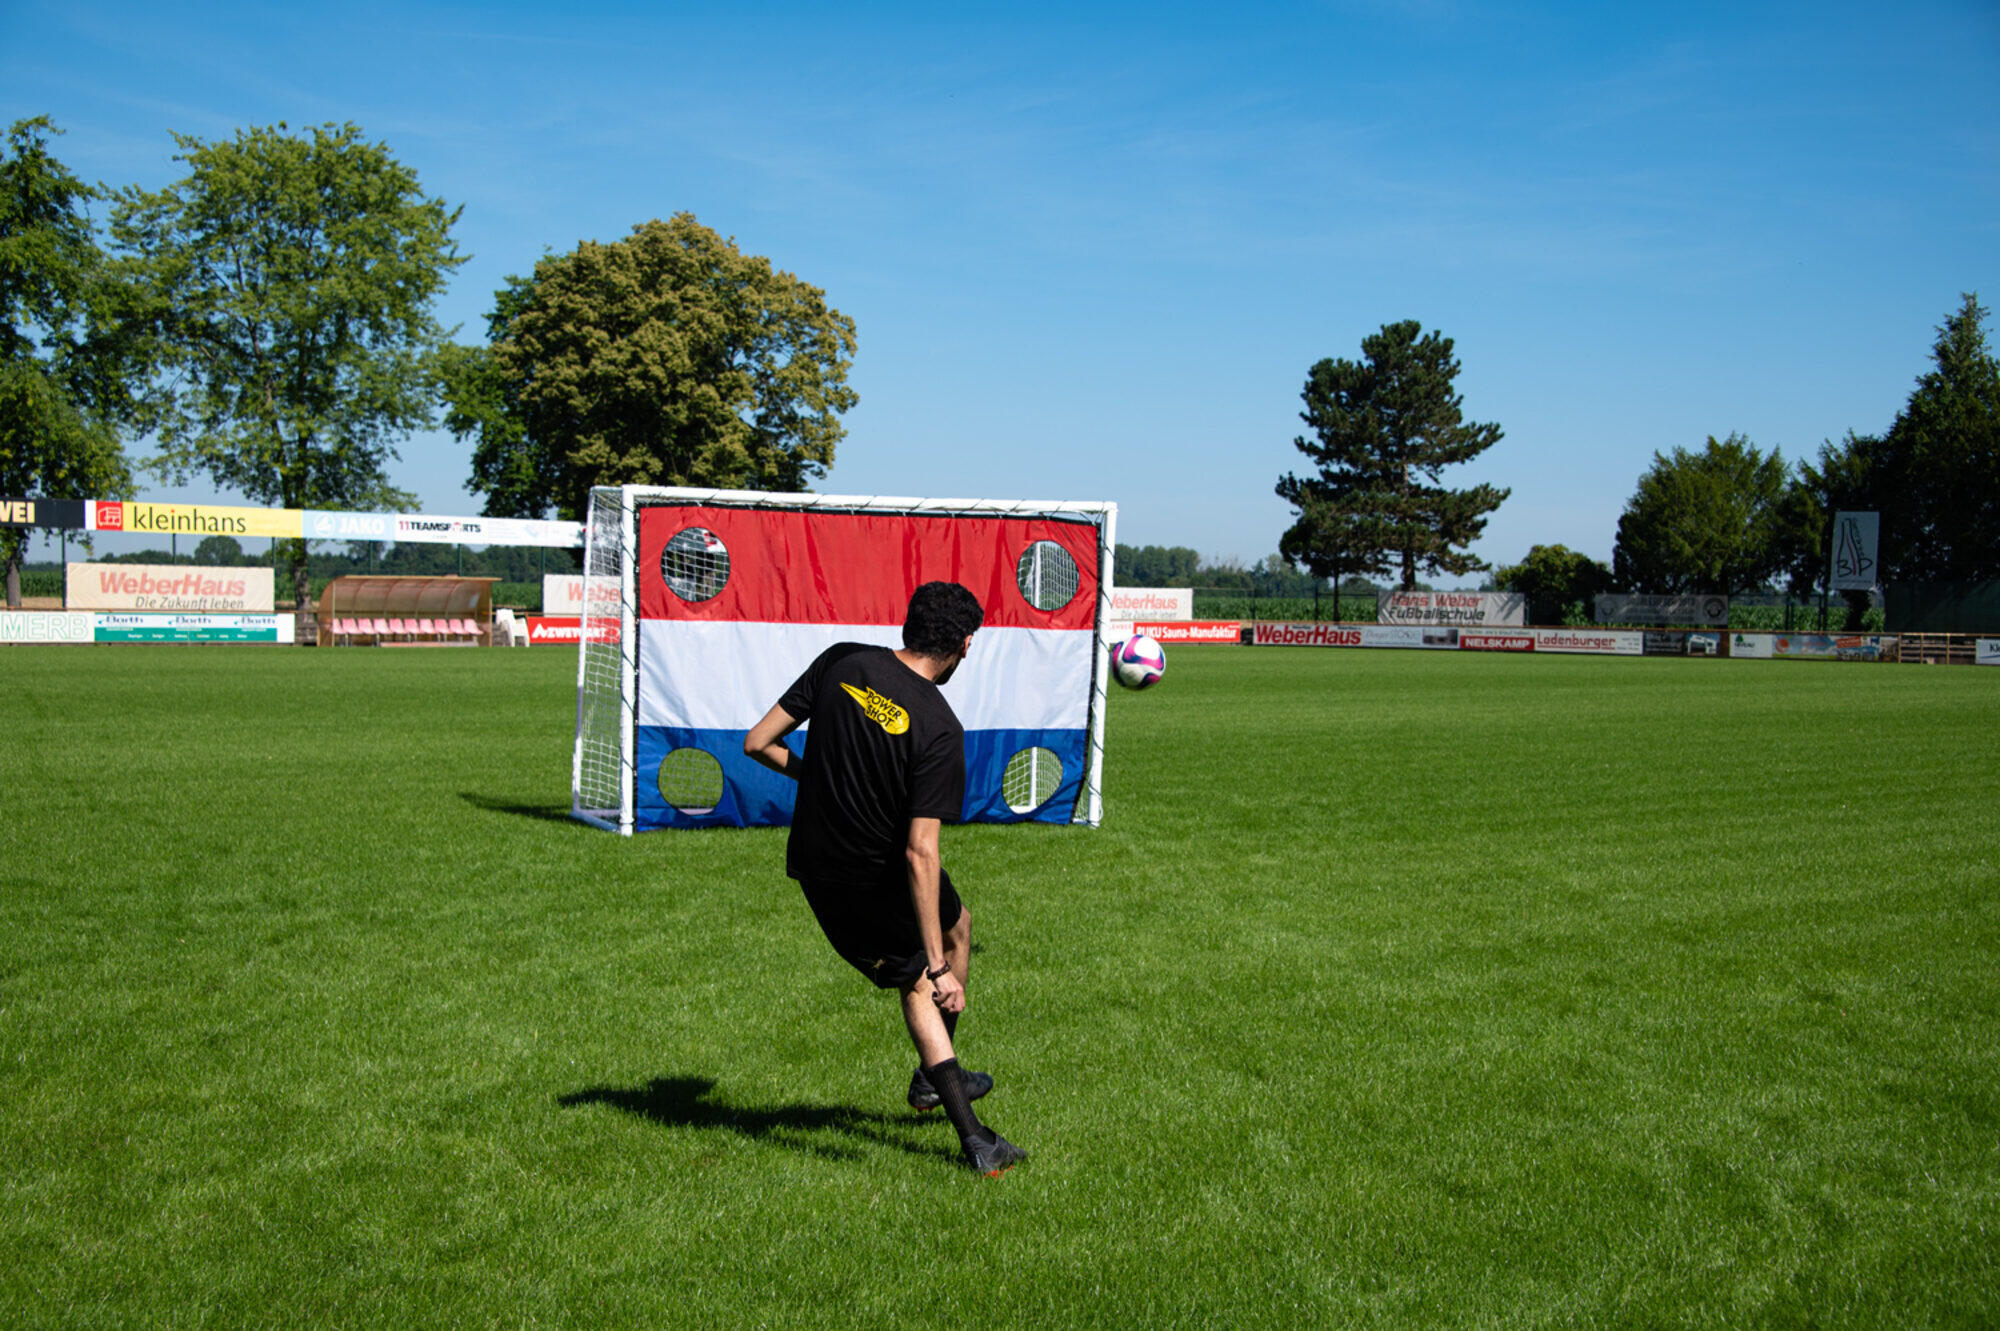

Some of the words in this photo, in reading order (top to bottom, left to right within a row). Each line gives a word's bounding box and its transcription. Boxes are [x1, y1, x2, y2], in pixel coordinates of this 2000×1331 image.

[133, 506, 246, 533] kleinhans
[339, 518, 384, 535] JAKO
[100, 571, 245, 596] WeberHaus
[135, 596, 157, 608] Die
[160, 597, 208, 609] Zukunft
[210, 598, 244, 609] leben
[1112, 593, 1178, 610] eberHaus
[1391, 594, 1428, 607] Hans
[1435, 594, 1482, 607] Weber
[1389, 607, 1485, 620] Fußballschule
[1162, 626, 1237, 639] Sauna-Manufaktur
[1256, 624, 1361, 645] WeberHaus
[1537, 632, 1616, 649] Ladenburger
[1465, 638, 1530, 649] NELSKAMP
[867, 691, 902, 720] POWER
[866, 705, 894, 727] SHOT
